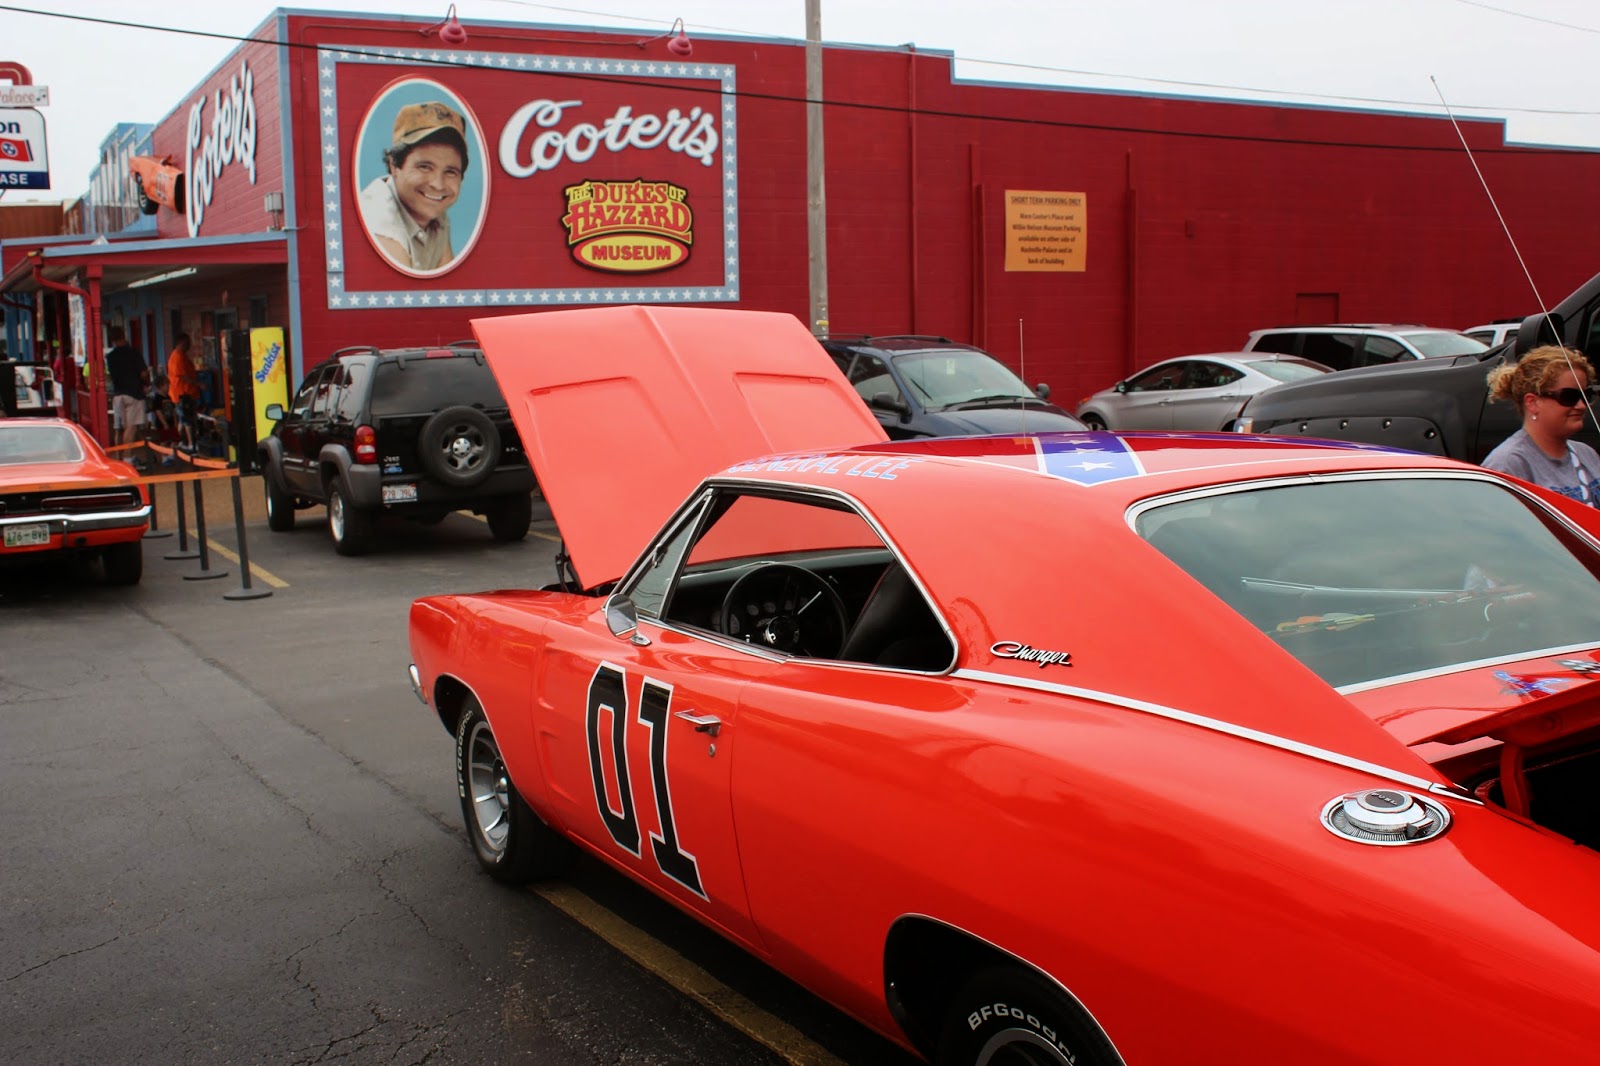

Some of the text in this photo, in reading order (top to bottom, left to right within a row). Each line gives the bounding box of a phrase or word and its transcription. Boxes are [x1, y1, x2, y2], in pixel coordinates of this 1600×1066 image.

[0, 88, 35, 104] alace
[185, 59, 257, 239] Cooter's
[498, 99, 719, 178] Cooter's
[566, 180, 686, 204] THE DUKES OF
[1011, 196, 1028, 204] SHORT
[1029, 196, 1043, 204] TERM
[1044, 197, 1068, 206] PARKING
[562, 199, 692, 244] HAZZARD
[591, 245, 672, 261] MUSEUM
[255, 342, 281, 383] Sunkist
[845, 454, 924, 480] LEE
[990, 641, 1071, 668] Charger
[586, 660, 711, 902] 01
